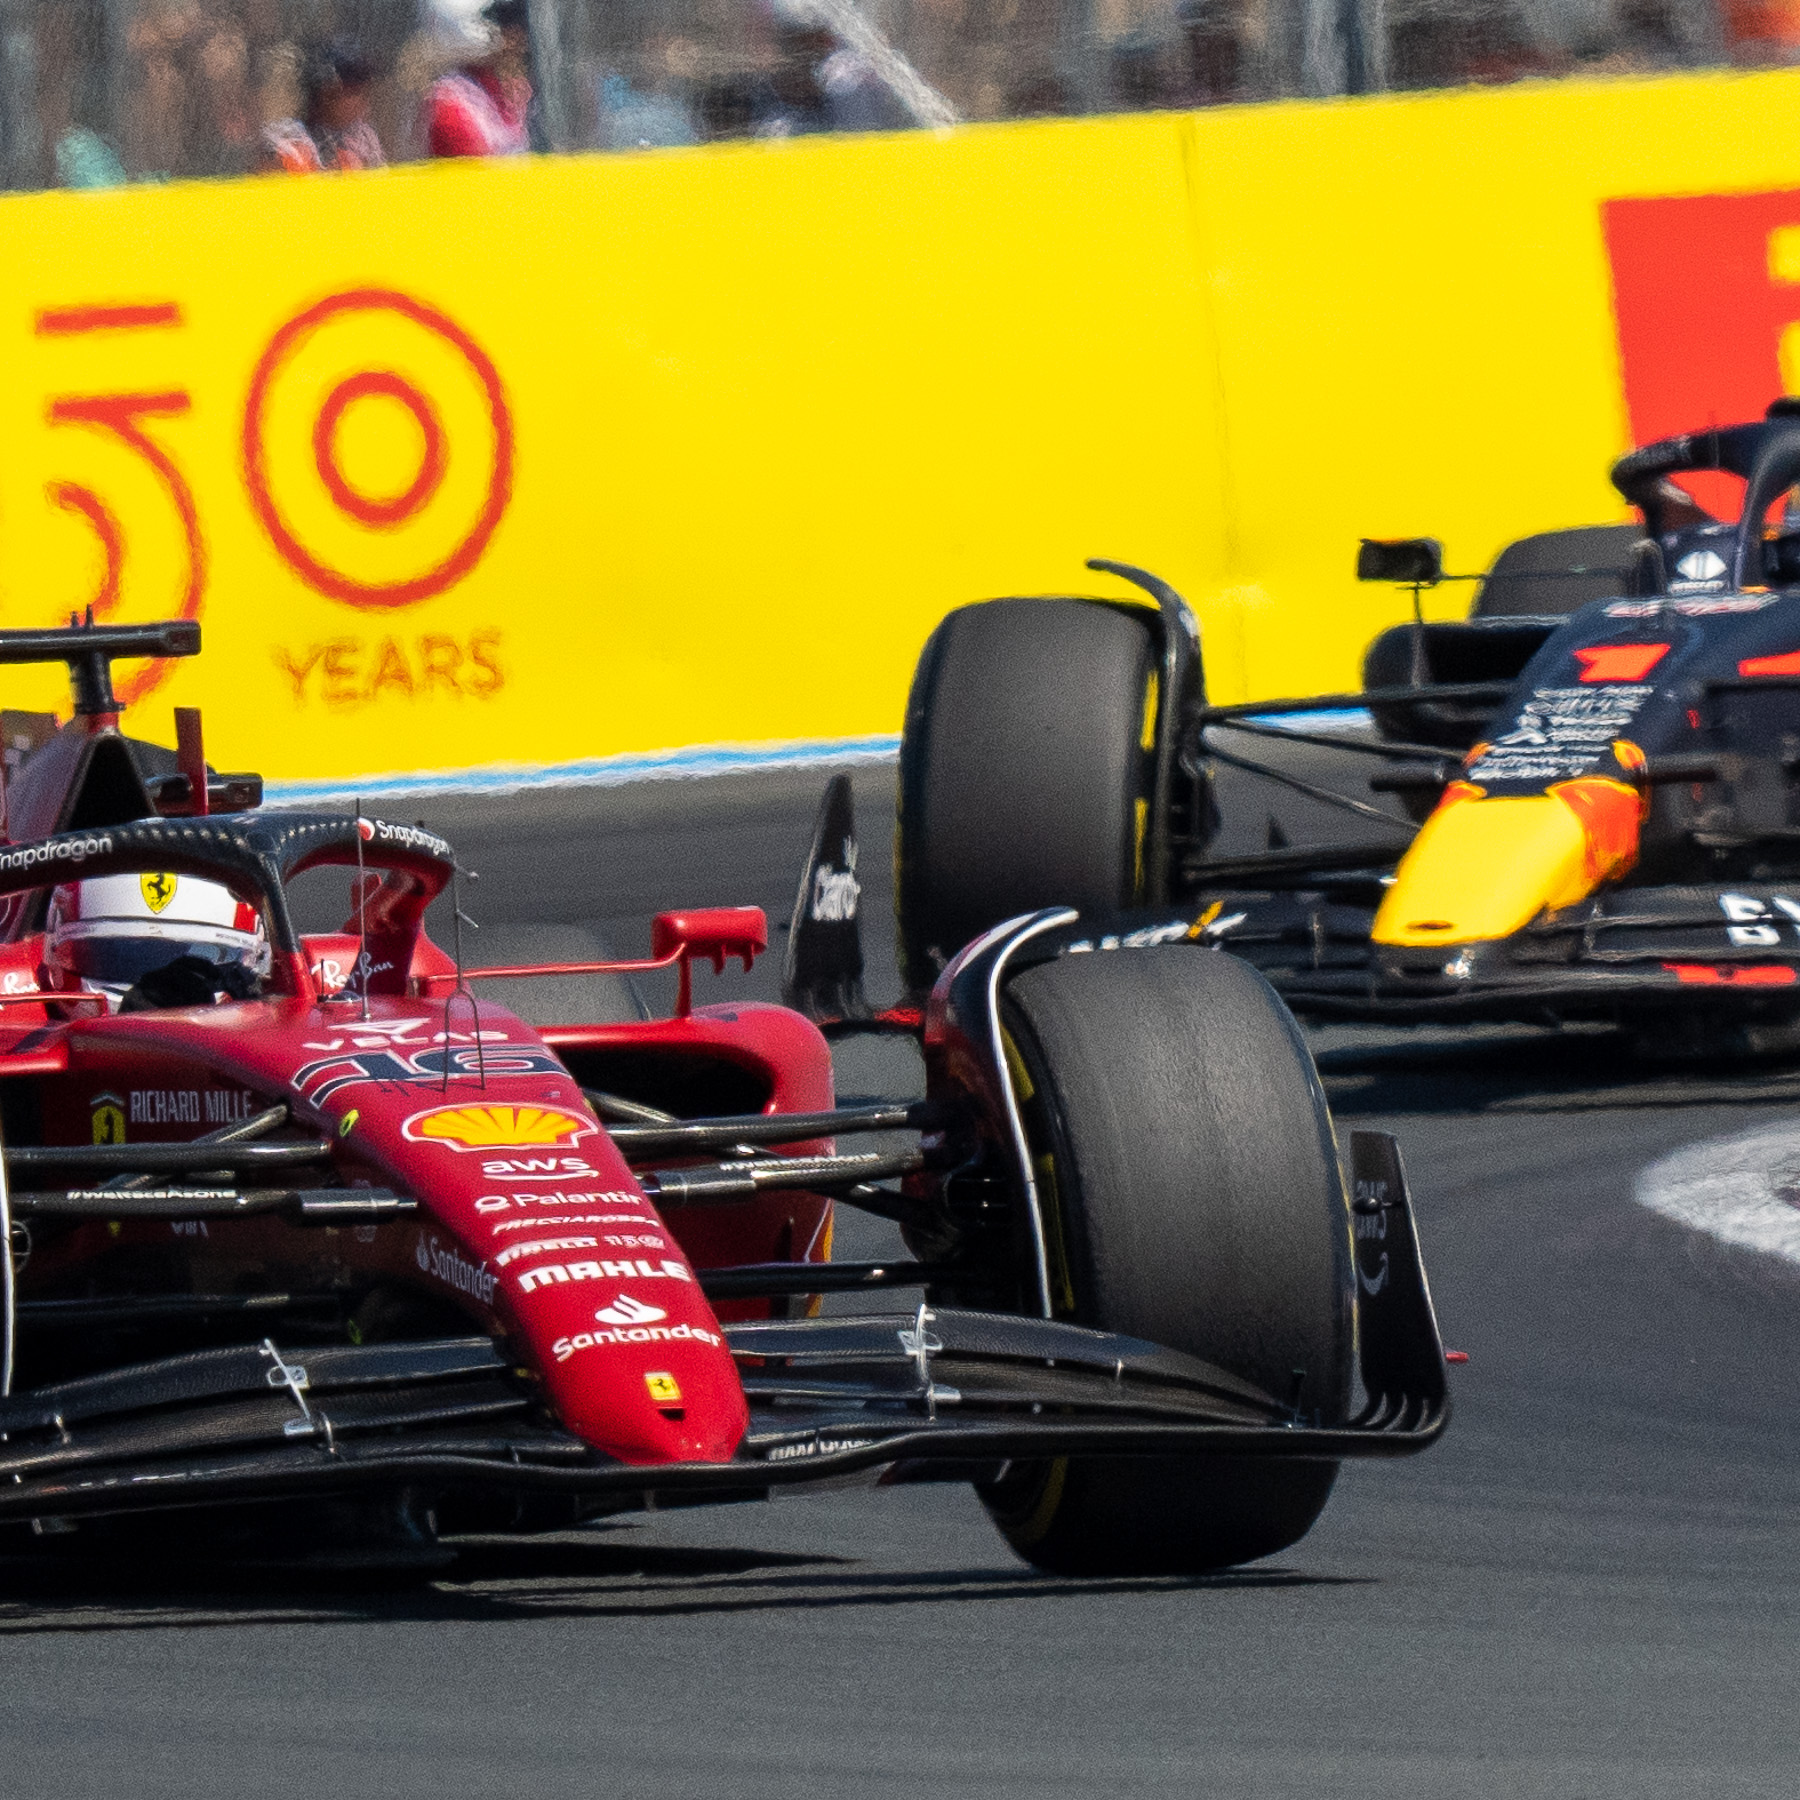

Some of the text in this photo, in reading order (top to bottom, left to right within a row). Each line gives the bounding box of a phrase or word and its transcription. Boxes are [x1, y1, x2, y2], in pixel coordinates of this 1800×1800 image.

[277, 630, 506, 709] YEARS
[376, 819, 450, 856] Snapdragon
[291, 1044, 574, 1110] 16
[130, 1090, 201, 1122] RICHARD
[482, 1156, 592, 1176] aws
[513, 1190, 643, 1208] Palantir
[430, 1236, 500, 1305] Santander
[517, 1258, 693, 1294] MAHLE
[552, 1324, 721, 1363] Santander
